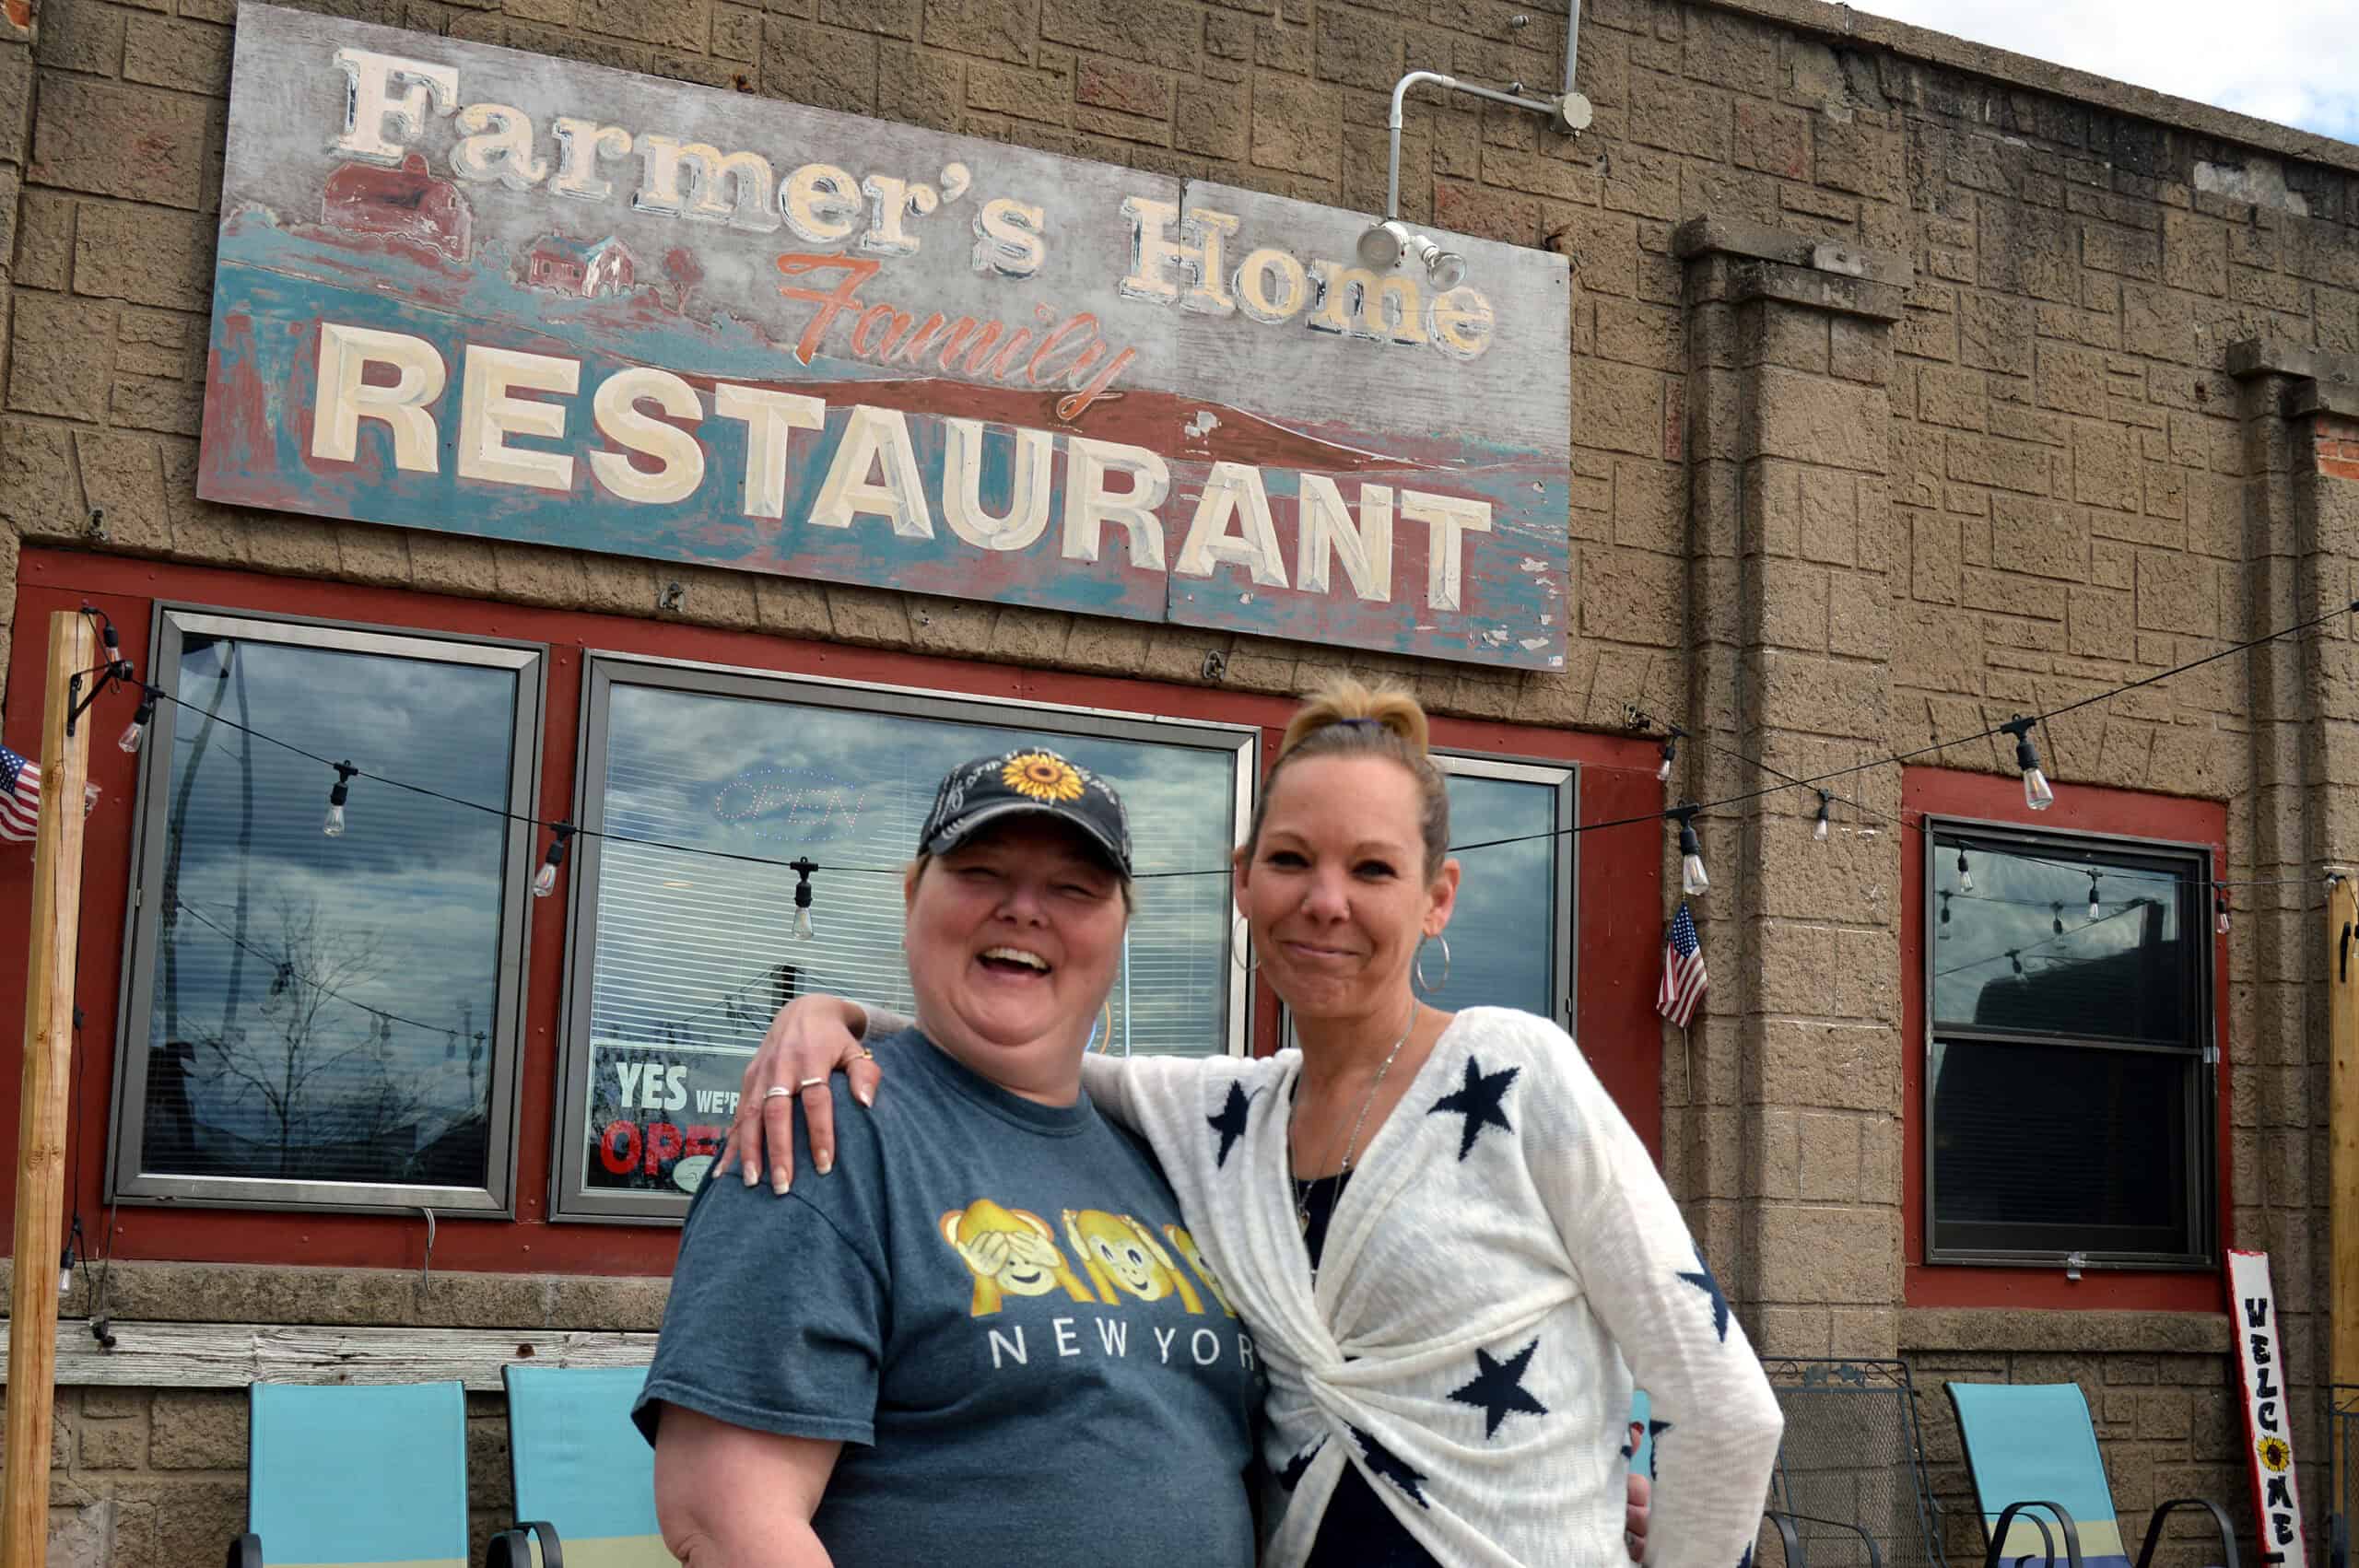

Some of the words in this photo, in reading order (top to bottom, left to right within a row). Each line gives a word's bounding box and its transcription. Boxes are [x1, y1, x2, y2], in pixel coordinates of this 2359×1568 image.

[328, 46, 1045, 277] Farmer's
[1120, 195, 1496, 360] Home
[776, 251, 1135, 421] Family
[311, 322, 1493, 613] RESTAURANT
[715, 781, 864, 833] OPEN
[616, 1062, 687, 1111] YES
[696, 1090, 741, 1115] WE'R
[600, 1119, 734, 1176] OPE
[988, 1317, 1127, 1369] NEW
[1154, 1327, 1254, 1371] YOR
